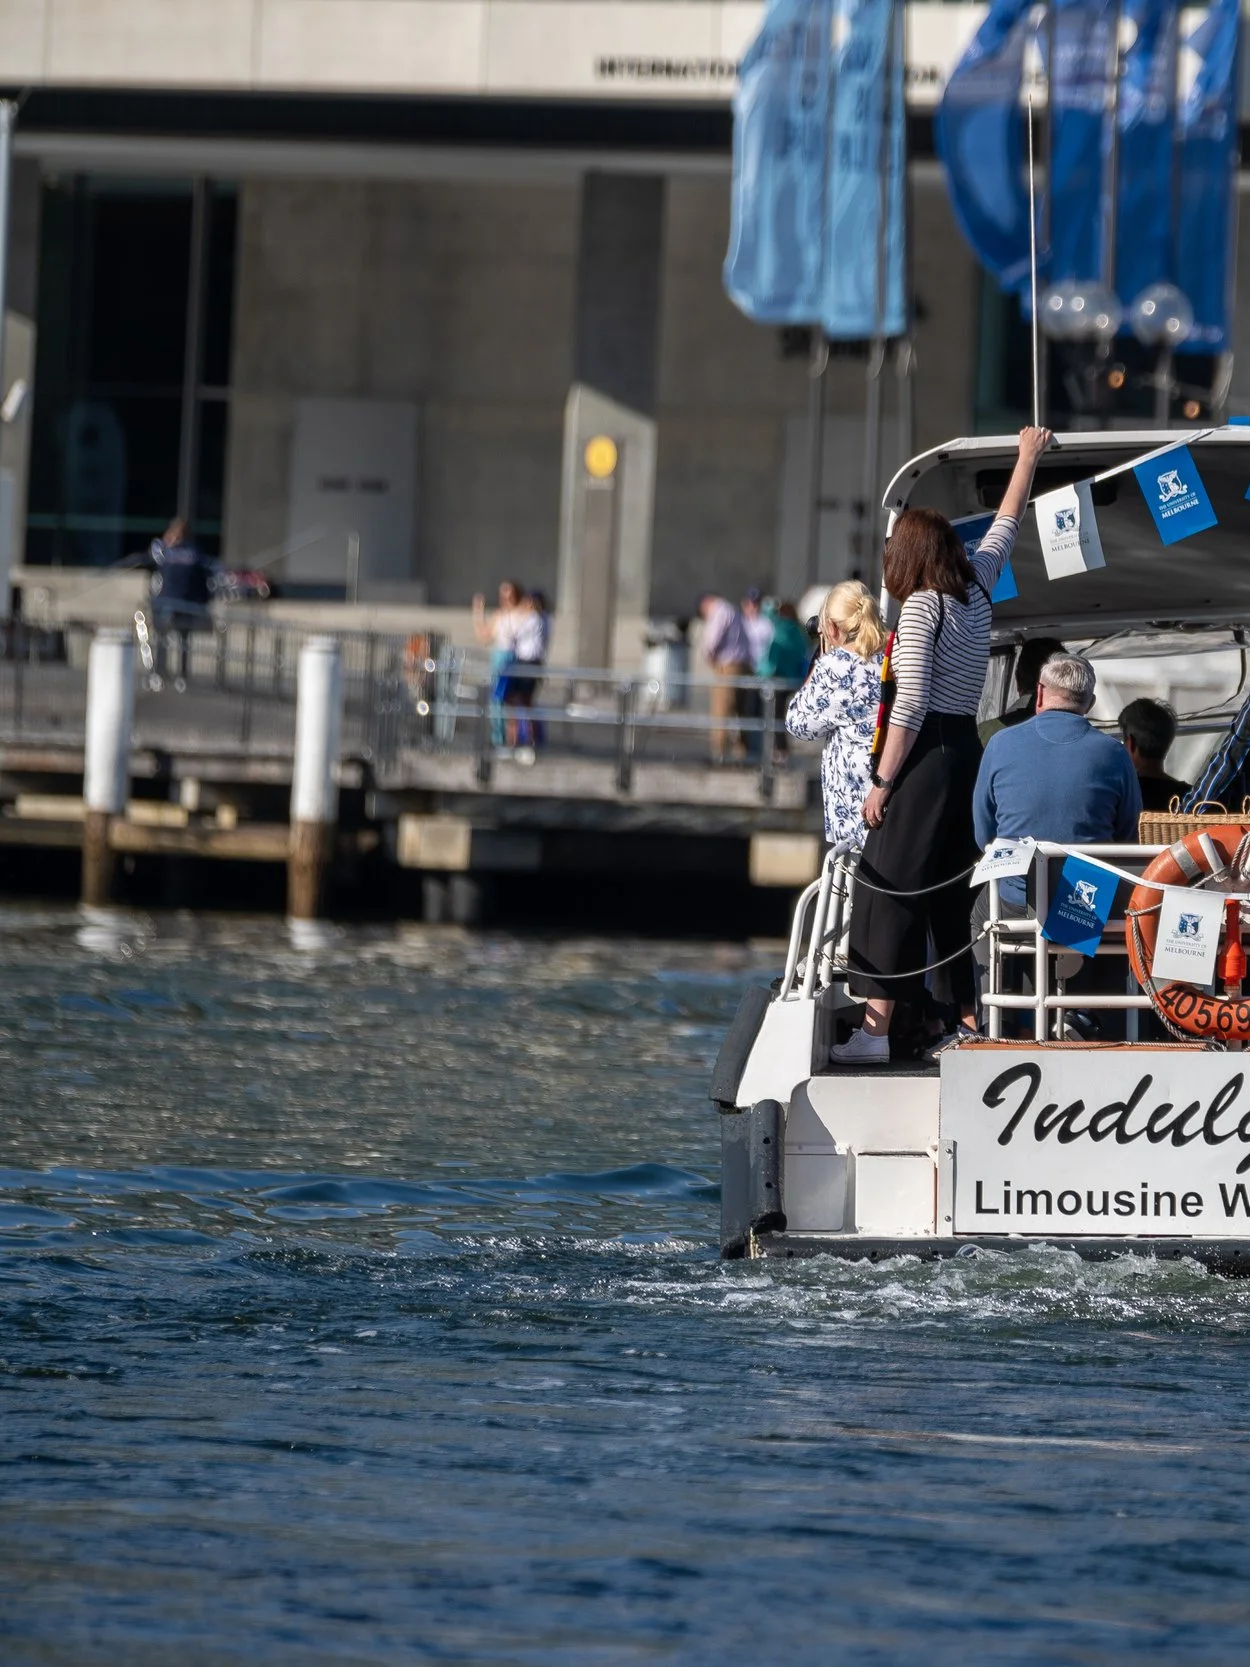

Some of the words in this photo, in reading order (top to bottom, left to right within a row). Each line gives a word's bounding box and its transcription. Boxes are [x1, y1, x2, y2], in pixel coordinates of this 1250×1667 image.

[1161, 498, 1199, 519] MELBOURNE
[1057, 909, 1095, 929] MELBOURNE
[1164, 946, 1206, 957] MELBOURNE
[974, 1180, 1205, 1218] Limousine
